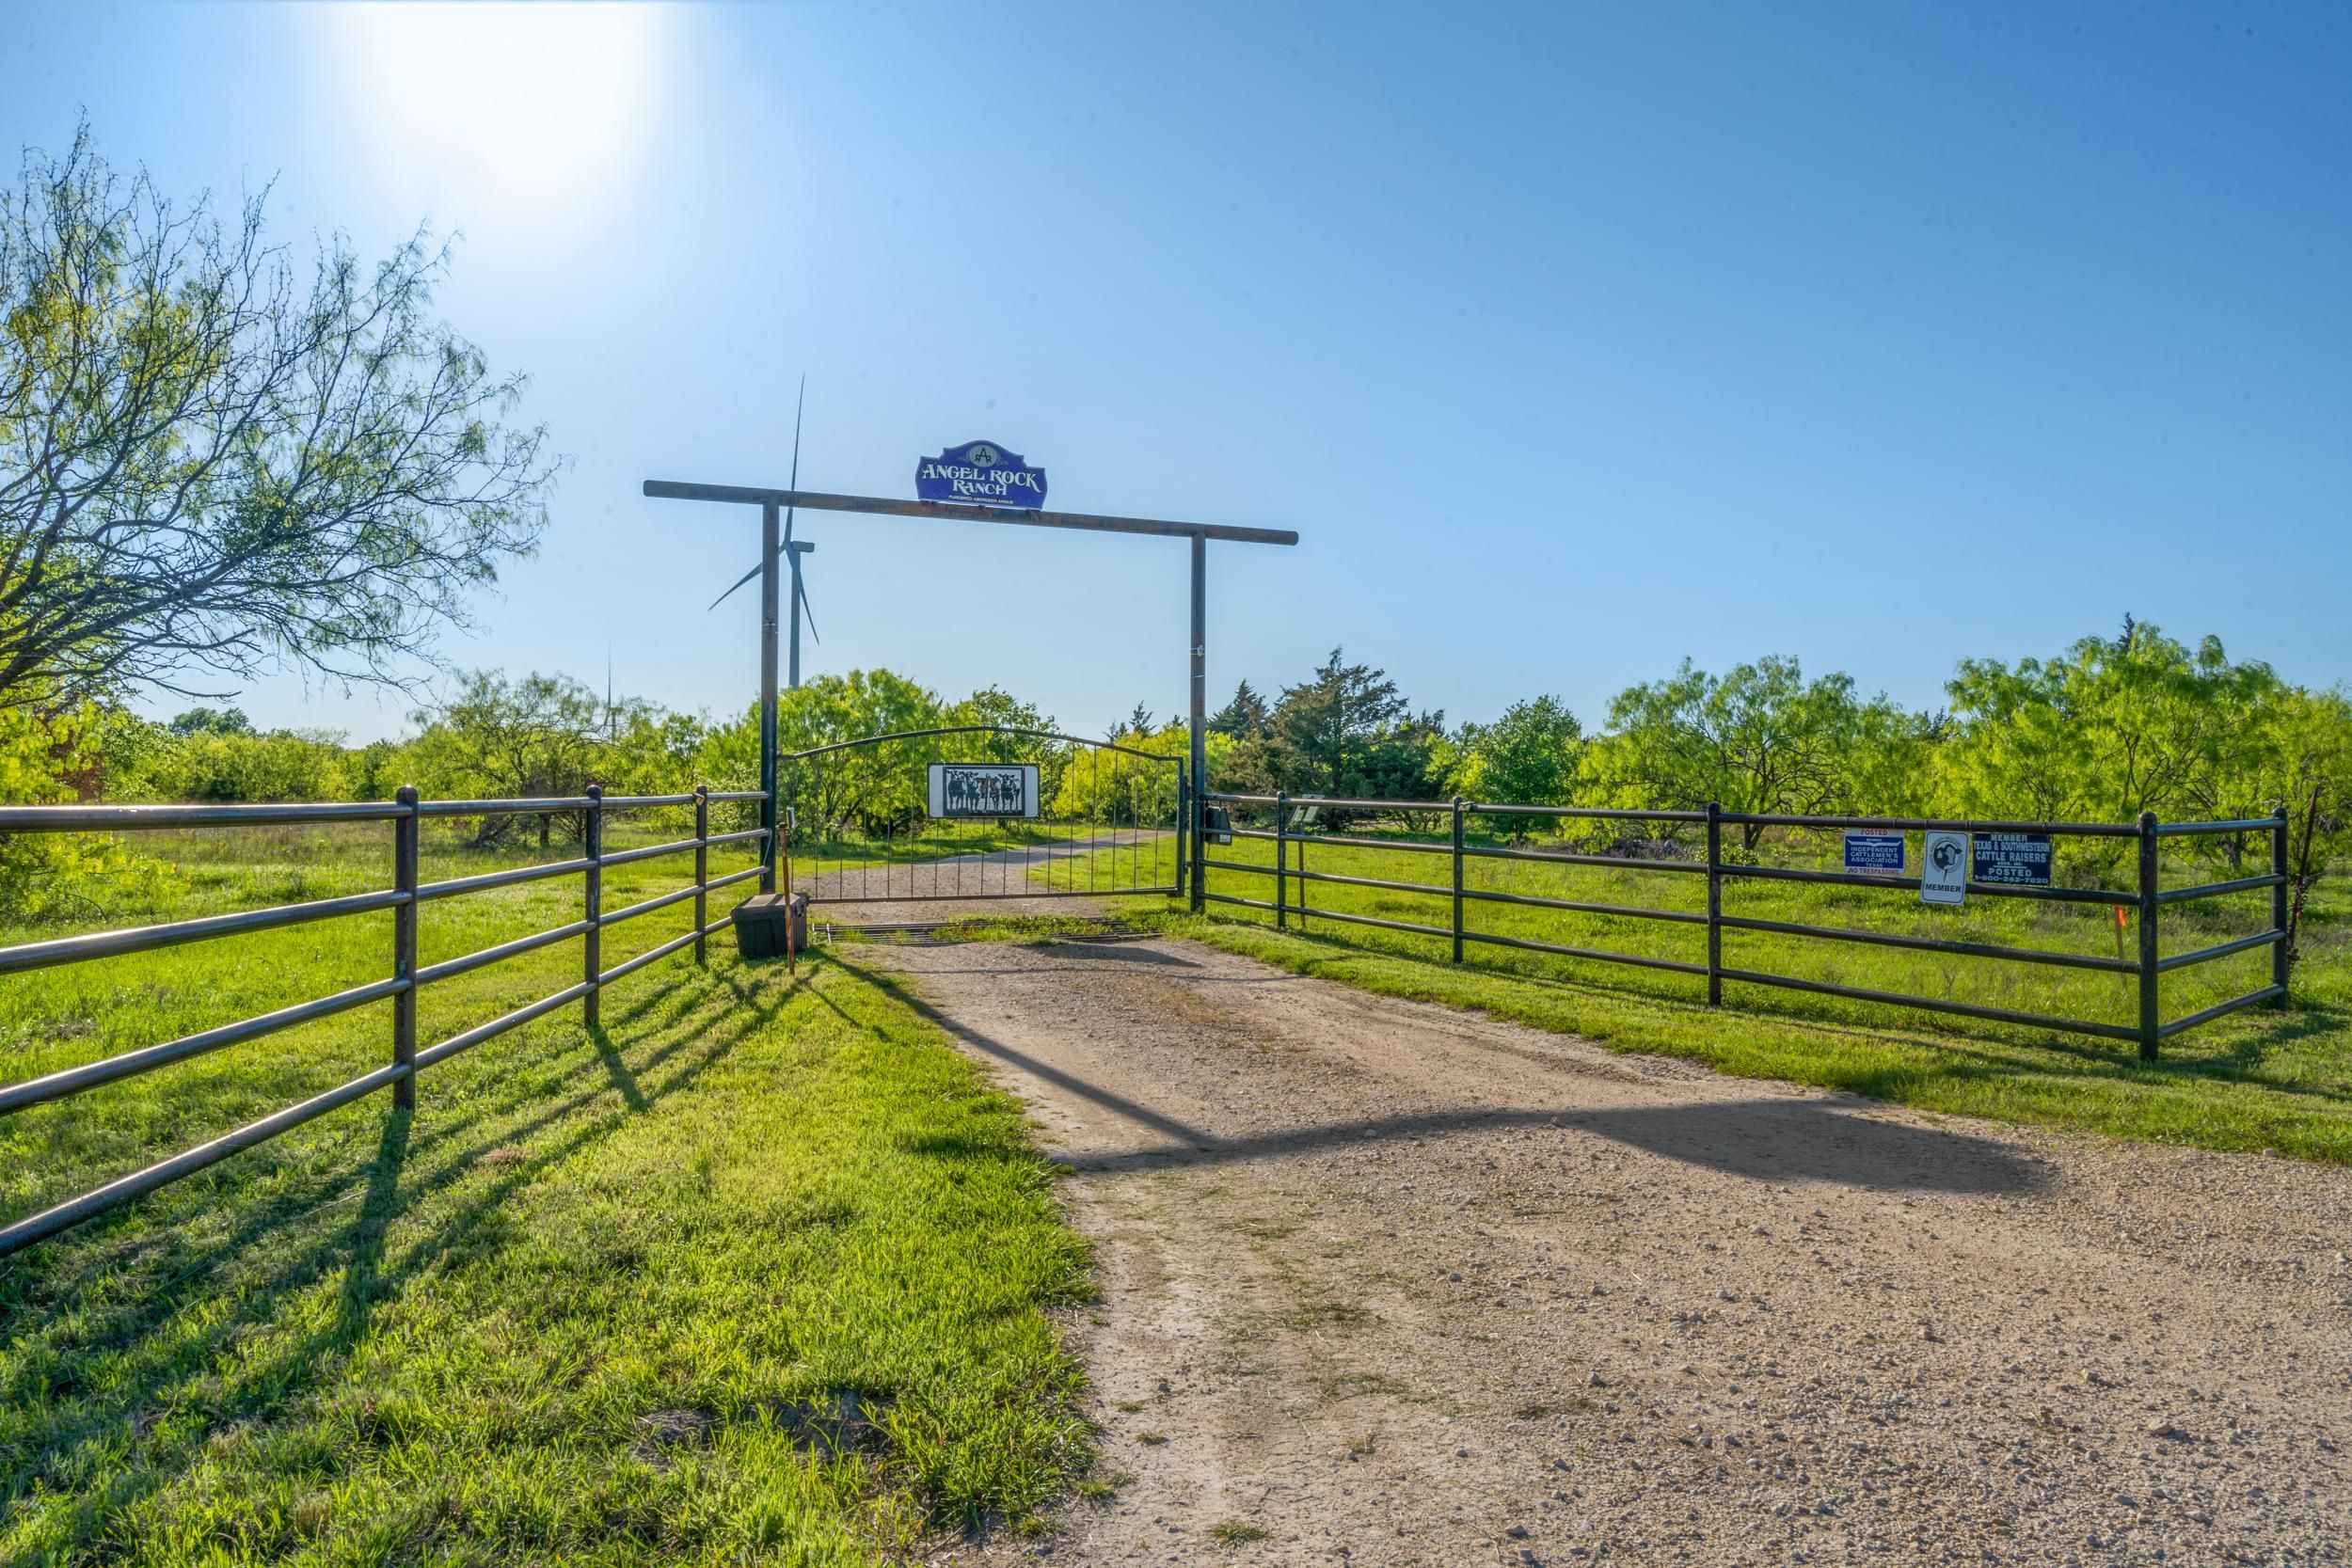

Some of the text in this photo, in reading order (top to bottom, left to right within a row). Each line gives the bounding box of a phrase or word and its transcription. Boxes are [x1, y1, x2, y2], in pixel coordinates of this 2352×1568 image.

[922, 464, 1042, 493] ANGEL ROCK
[952, 479, 1007, 496] RANCH
[1991, 833, 2027, 842] MEMBER
[1973, 841, 1992, 850] TEXAS
[2000, 842, 2050, 852] SOUTHWESTERN
[1976, 850, 2006, 862] CATTLE
[1988, 867, 2032, 877] POSTED
[1925, 883, 1962, 893] MEMBER
